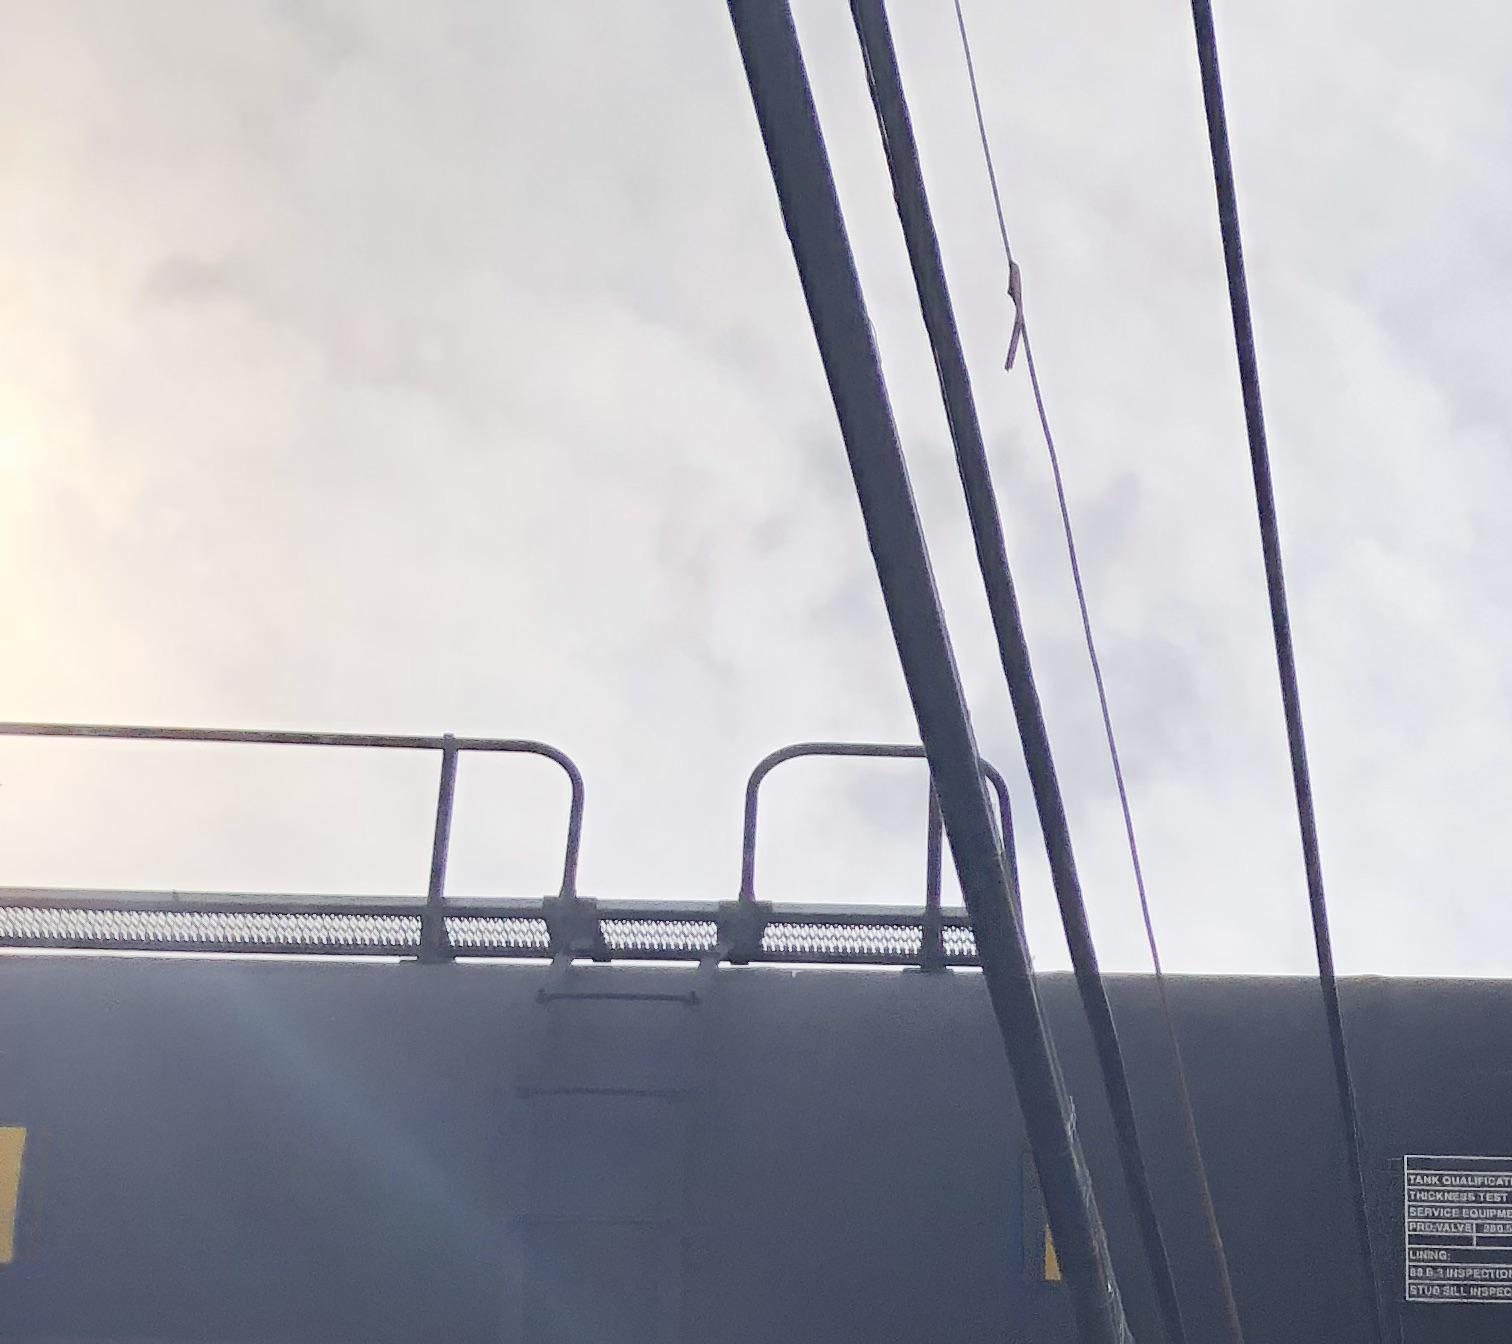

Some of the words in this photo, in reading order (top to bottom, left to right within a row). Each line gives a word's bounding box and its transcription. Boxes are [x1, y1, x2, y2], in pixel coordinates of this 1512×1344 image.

[1409, 1175, 1439, 1184] TANK
[1409, 1191, 1475, 1202] THICKNESS
[1478, 1193, 1508, 1202] TEST
[1409, 1207, 1459, 1217] SERVICE
